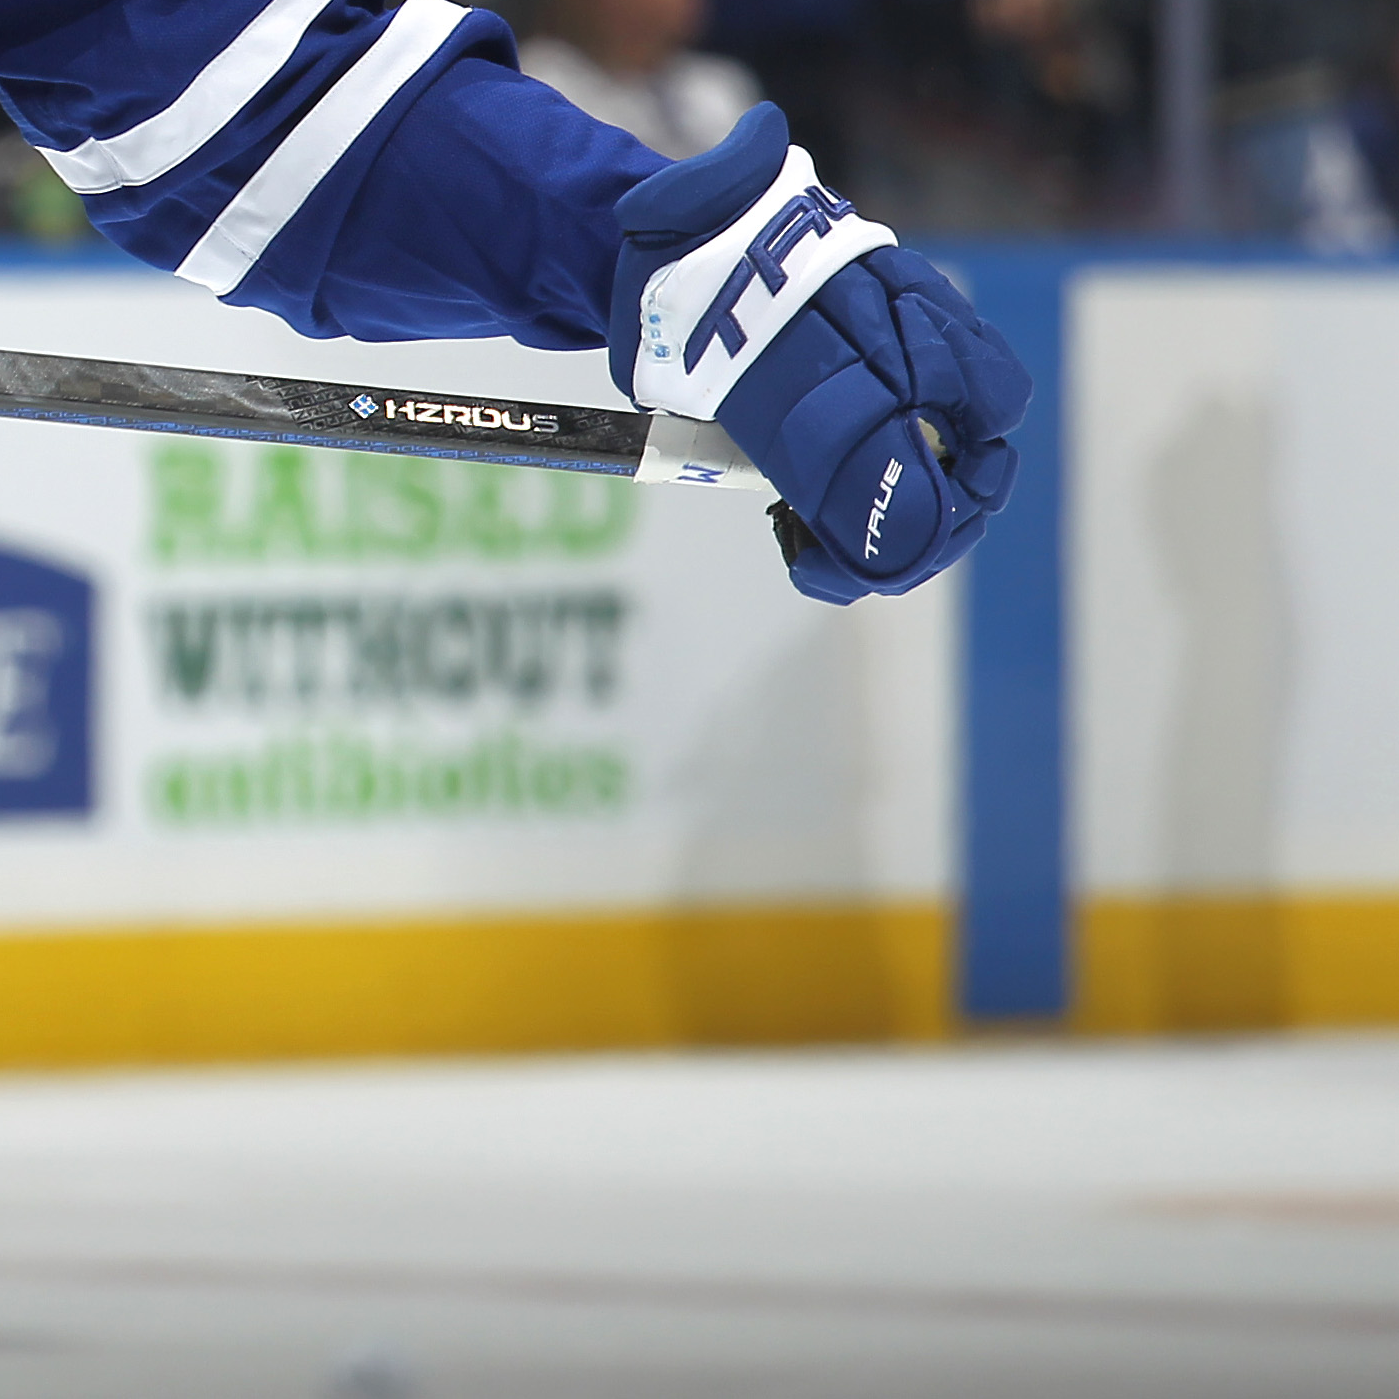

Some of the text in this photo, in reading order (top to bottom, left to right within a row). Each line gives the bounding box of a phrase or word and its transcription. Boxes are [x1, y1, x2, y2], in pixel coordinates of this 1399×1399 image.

[683, 184, 858, 375] TRU
[385, 397, 561, 436] HZRDUS
[864, 458, 904, 560] TRUE
[148, 591, 633, 706] WITHOUT
[148, 731, 630, 821] antibiotics
